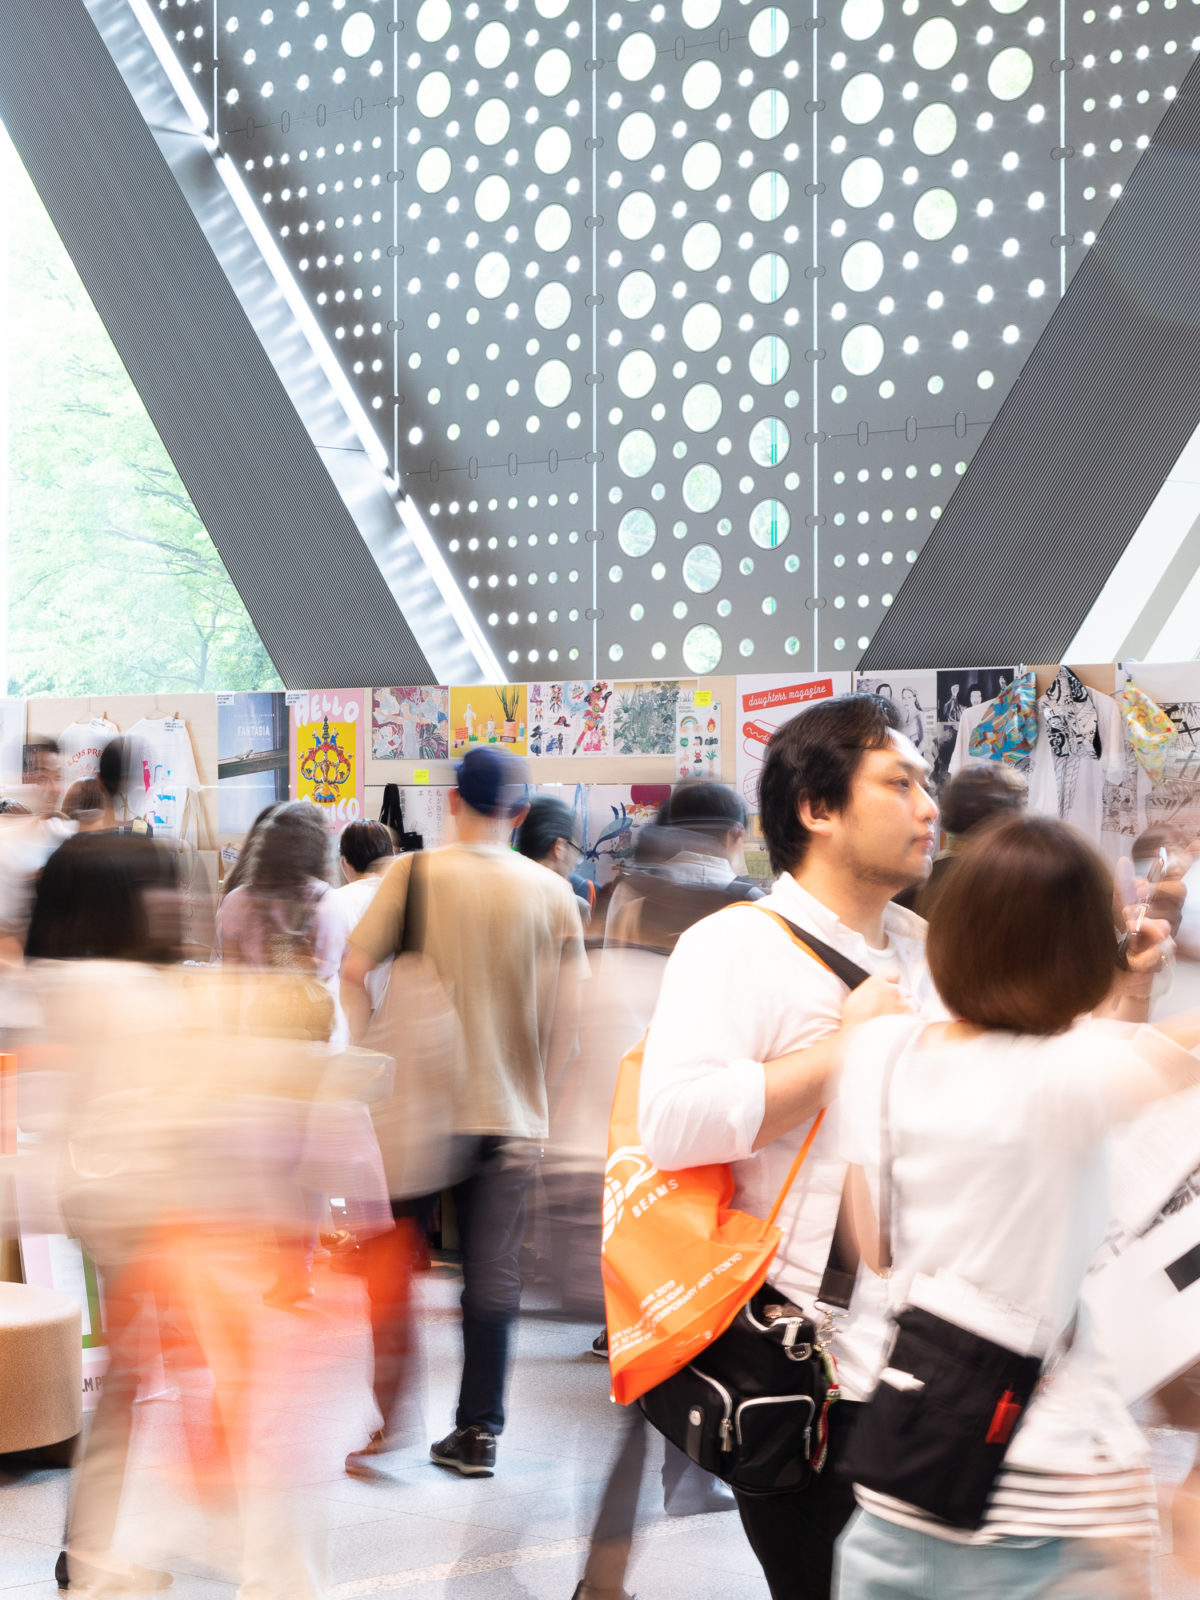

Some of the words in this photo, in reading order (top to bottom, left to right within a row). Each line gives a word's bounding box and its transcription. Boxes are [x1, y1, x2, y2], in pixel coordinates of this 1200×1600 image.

[294, 693, 360, 728] HELLO
[748, 691, 788, 708] daughters
[788, 684, 827, 700] magazine
[237, 725, 271, 737] FANTASIA
[631, 1178, 679, 1218] BEAMS
[697, 1273, 714, 1289] ART
[712, 1252, 743, 1276] TOKYO
